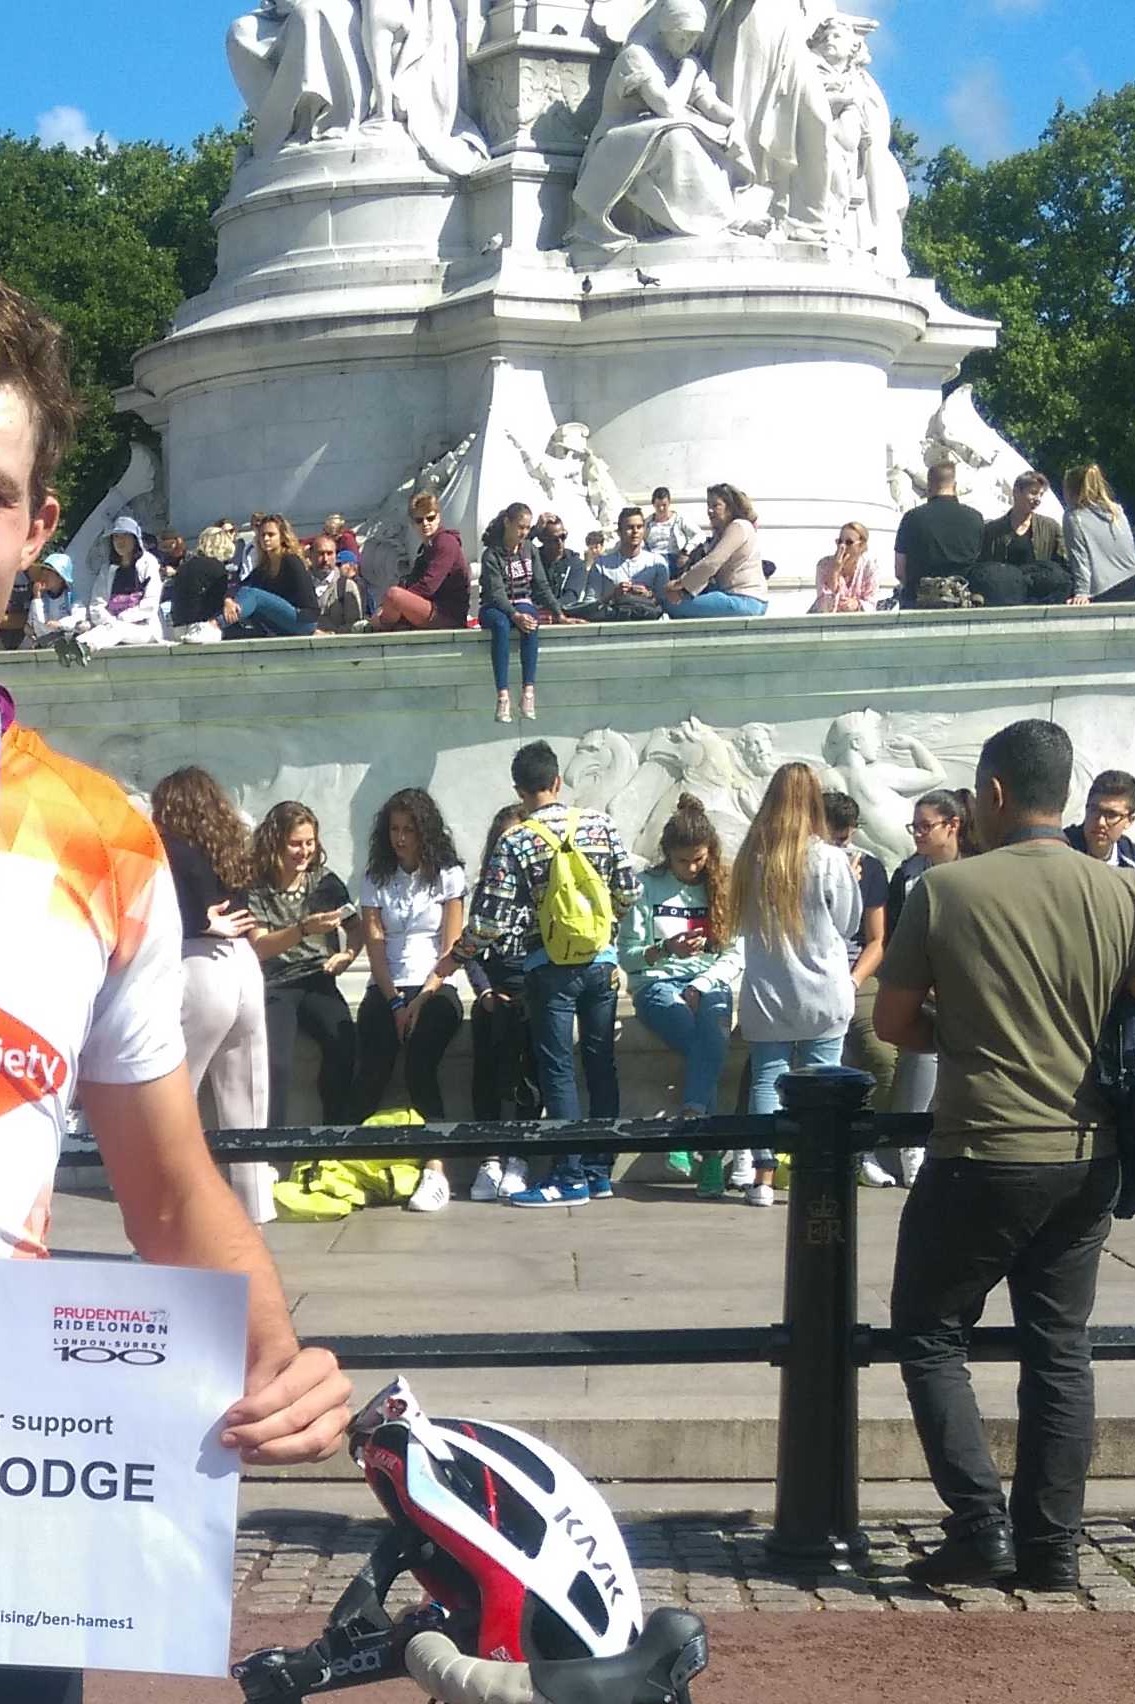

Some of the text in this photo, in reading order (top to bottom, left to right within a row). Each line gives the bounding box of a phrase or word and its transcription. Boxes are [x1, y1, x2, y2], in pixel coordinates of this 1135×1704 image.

[53, 1306, 151, 1323] PRUDENTIAL
[53, 1319, 168, 1335] RIDELONDON
[53, 1346, 166, 1366] 100
[11, 1413, 114, 1438] support
[553, 1505, 624, 1607] KASK
